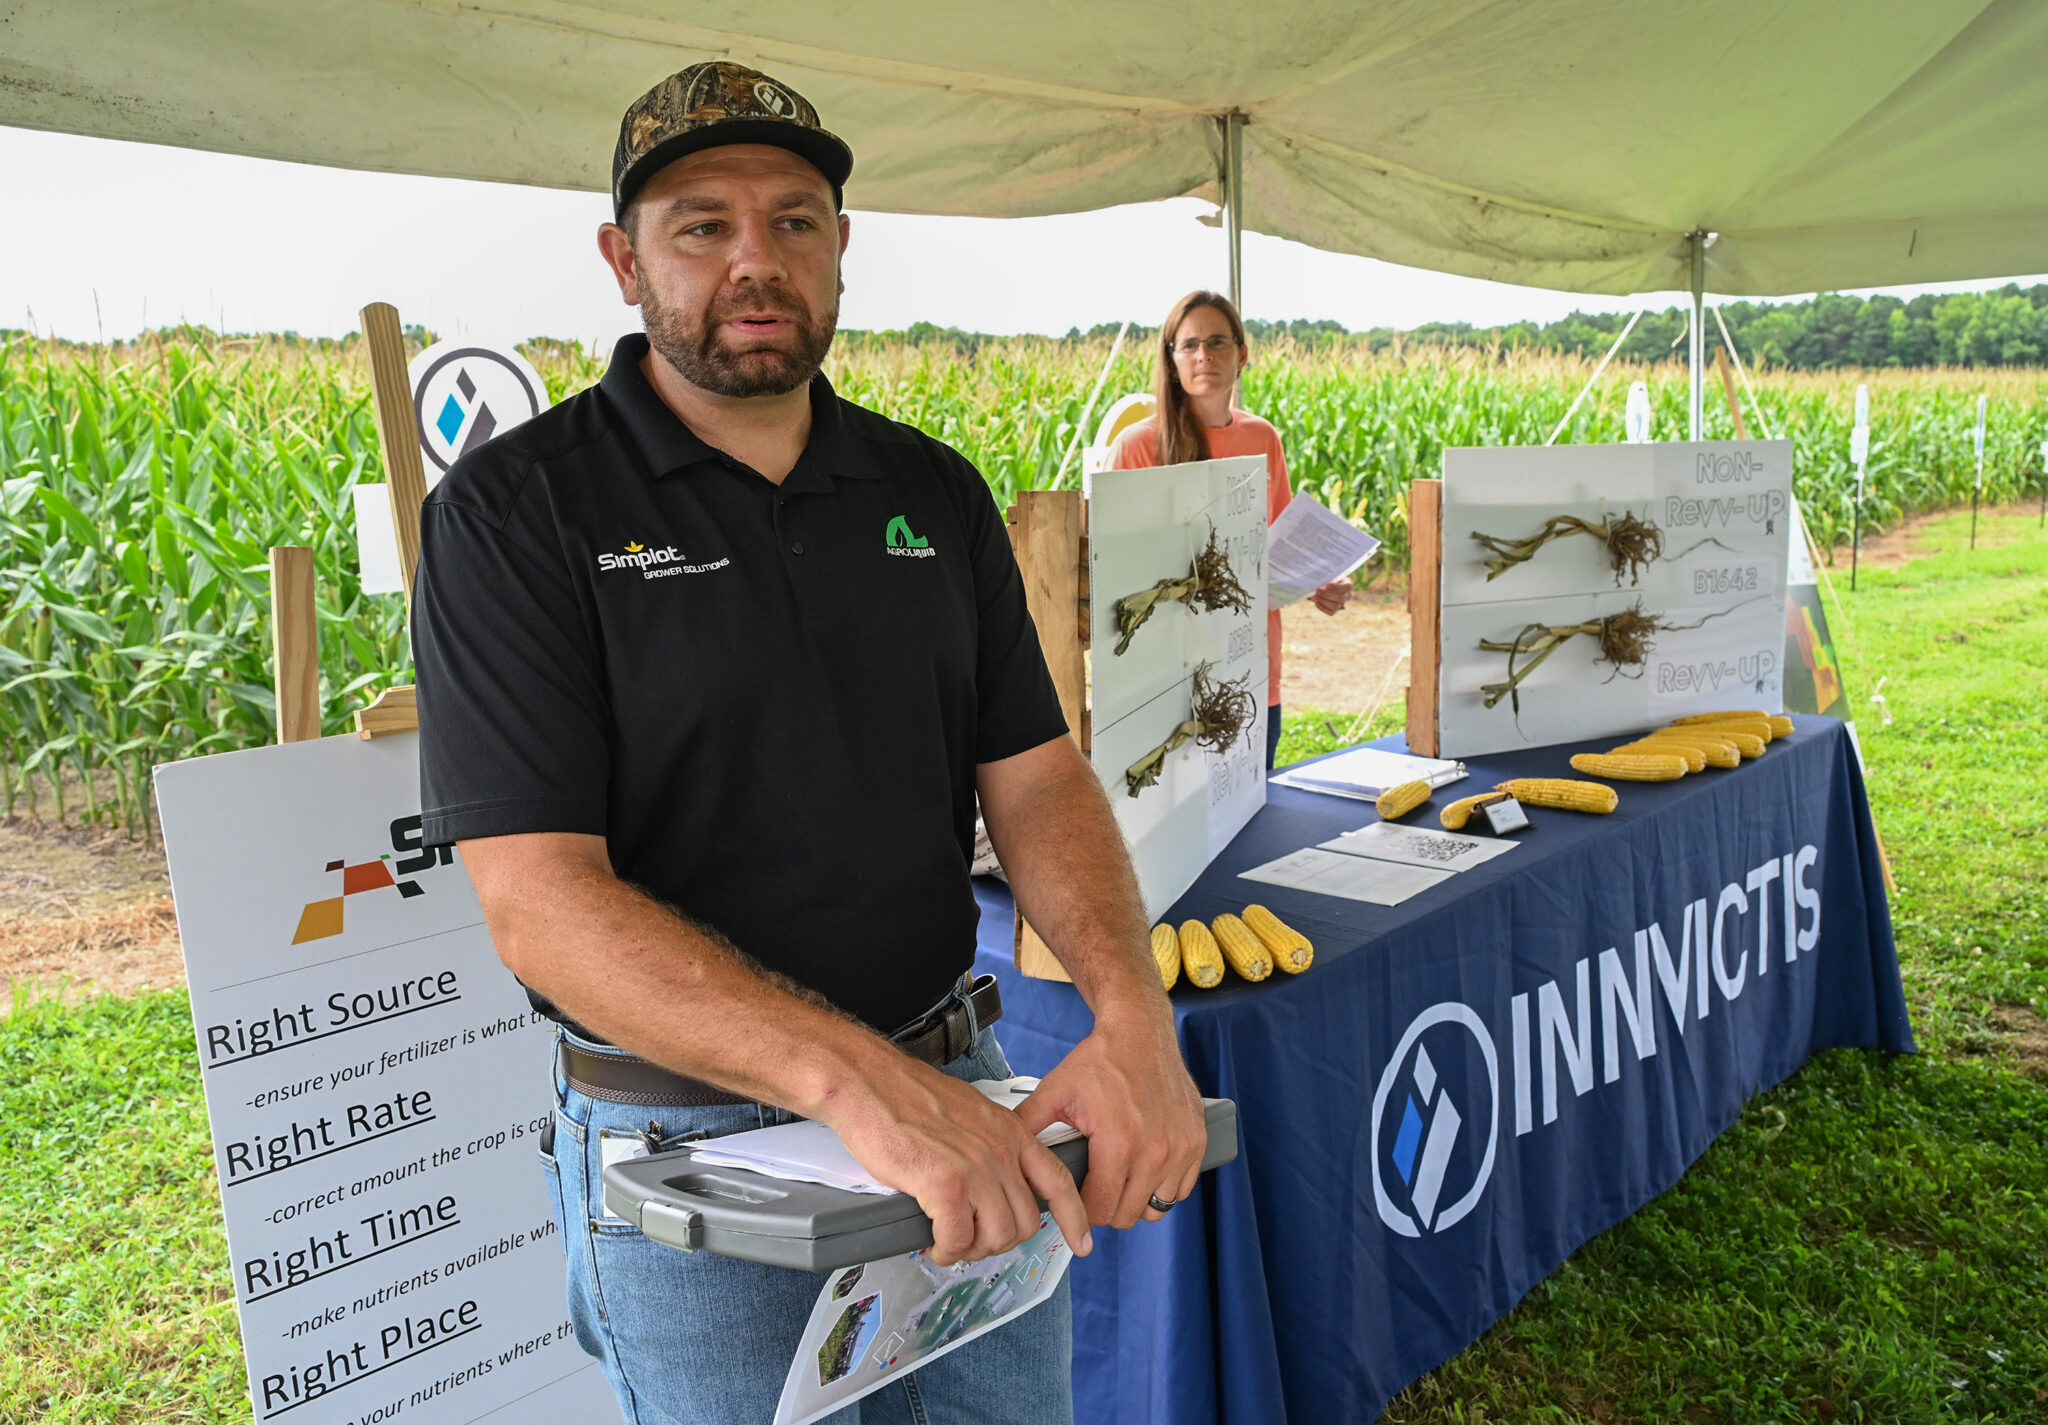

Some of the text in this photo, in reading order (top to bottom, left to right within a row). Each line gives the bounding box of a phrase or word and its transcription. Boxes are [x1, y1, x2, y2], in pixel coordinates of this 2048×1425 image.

[598, 546, 681, 571] Simplot
[644, 558, 730, 580] GROWER SOLUTIONS
[887, 546, 936, 558] AGROLIQUID
[1695, 567, 1758, 594] B1642
[207, 970, 457, 1059] Right Source
[1512, 844, 1821, 1137] INNVICTIS
[246, 1072, 323, 1108] -ensure
[330, 1061, 375, 1090] your
[379, 1034, 457, 1076] fertilizer
[463, 1027, 477, 1046] is
[481, 1013, 525, 1038] what
[226, 1089, 432, 1177] Right Rate
[264, 1184, 345, 1224] -correct
[350, 1157, 427, 1196] amount
[432, 1143, 461, 1169] the
[466, 1131, 506, 1164] crop
[511, 1124, 524, 1140] is
[244, 1194, 457, 1294] Right Time
[281, 1220, 558, 1340] -make nutrients available wh
[262, 1298, 479, 1411] Right Place
[361, 1398, 405, 1425] your
[410, 1358, 493, 1407] nutrients
[498, 1332, 551, 1366] where
